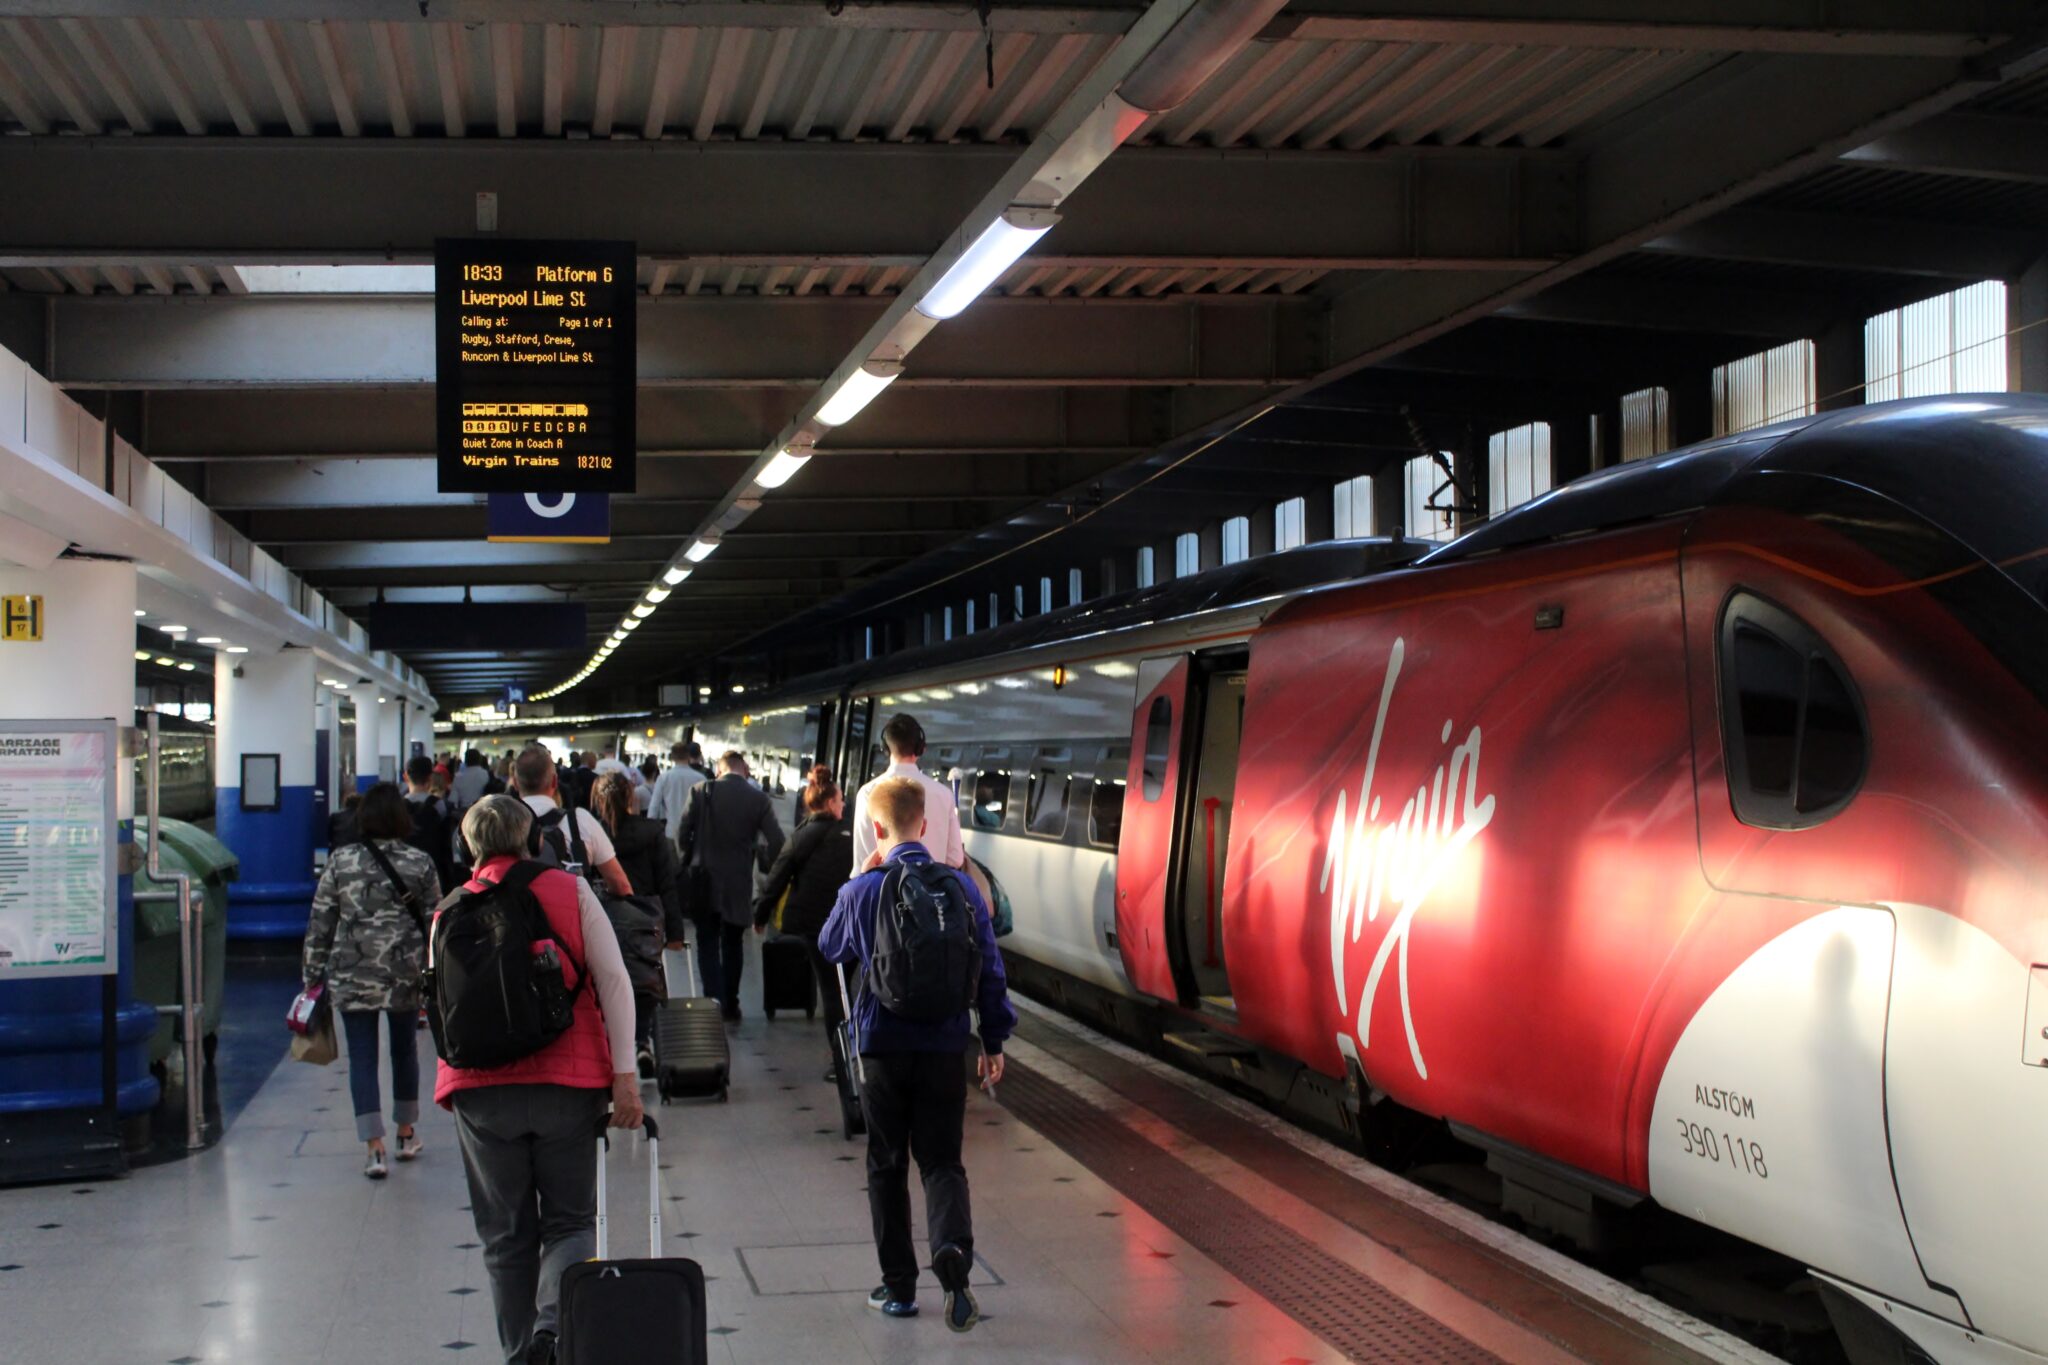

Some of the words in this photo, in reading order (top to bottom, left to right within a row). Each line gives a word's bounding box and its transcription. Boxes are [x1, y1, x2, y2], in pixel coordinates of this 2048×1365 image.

[464, 265, 502, 281] 18:33
[537, 266, 597, 282] Platform
[603, 267, 612, 283] 6
[462, 290, 527, 308] Liverpool
[534, 291, 563, 306] Lime
[570, 291, 586, 307] St
[462, 316, 492, 329] Calling
[496, 317, 509, 326] at:
[559, 317, 581, 329] Page
[584, 318, 589, 327] 1
[593, 318, 603, 327] of
[607, 318, 612, 328] 1
[462, 333, 492, 347] Rugby,
[496, 334, 540, 347] Stafford,
[544, 335, 575, 347] Crewe,
[462, 351, 499, 362] Runcorn
[503, 352, 509, 362] &
[513, 352, 556, 364] Liverpool
[560, 352, 579, 363] Lime
[582, 352, 593, 363] St
[511, 422, 518, 433] U
[523, 422, 530, 433] F
[534, 422, 541, 433] E
[546, 422, 553, 433] D
[557, 422, 564, 433] C
[568, 422, 575, 433] B
[580, 422, 587, 433] A
[463, 438, 487, 448] Quiet
[491, 438, 512, 448] Zone
[516, 438, 523, 448] in
[527, 438, 553, 448] Coach
[557, 438, 563, 448] A
[463, 455, 507, 468] Virgin
[514, 455, 559, 466] Trains
[18, 604, 24, 614] 6
[6, 599, 37, 637] H
[17, 623, 26, 632] 17
[1320, 637, 1496, 1081] Virgin
[1696, 1084, 1755, 1119] ALSTOM
[1677, 1118, 1719, 1162] 390
[1723, 1133, 1768, 1178] 118
